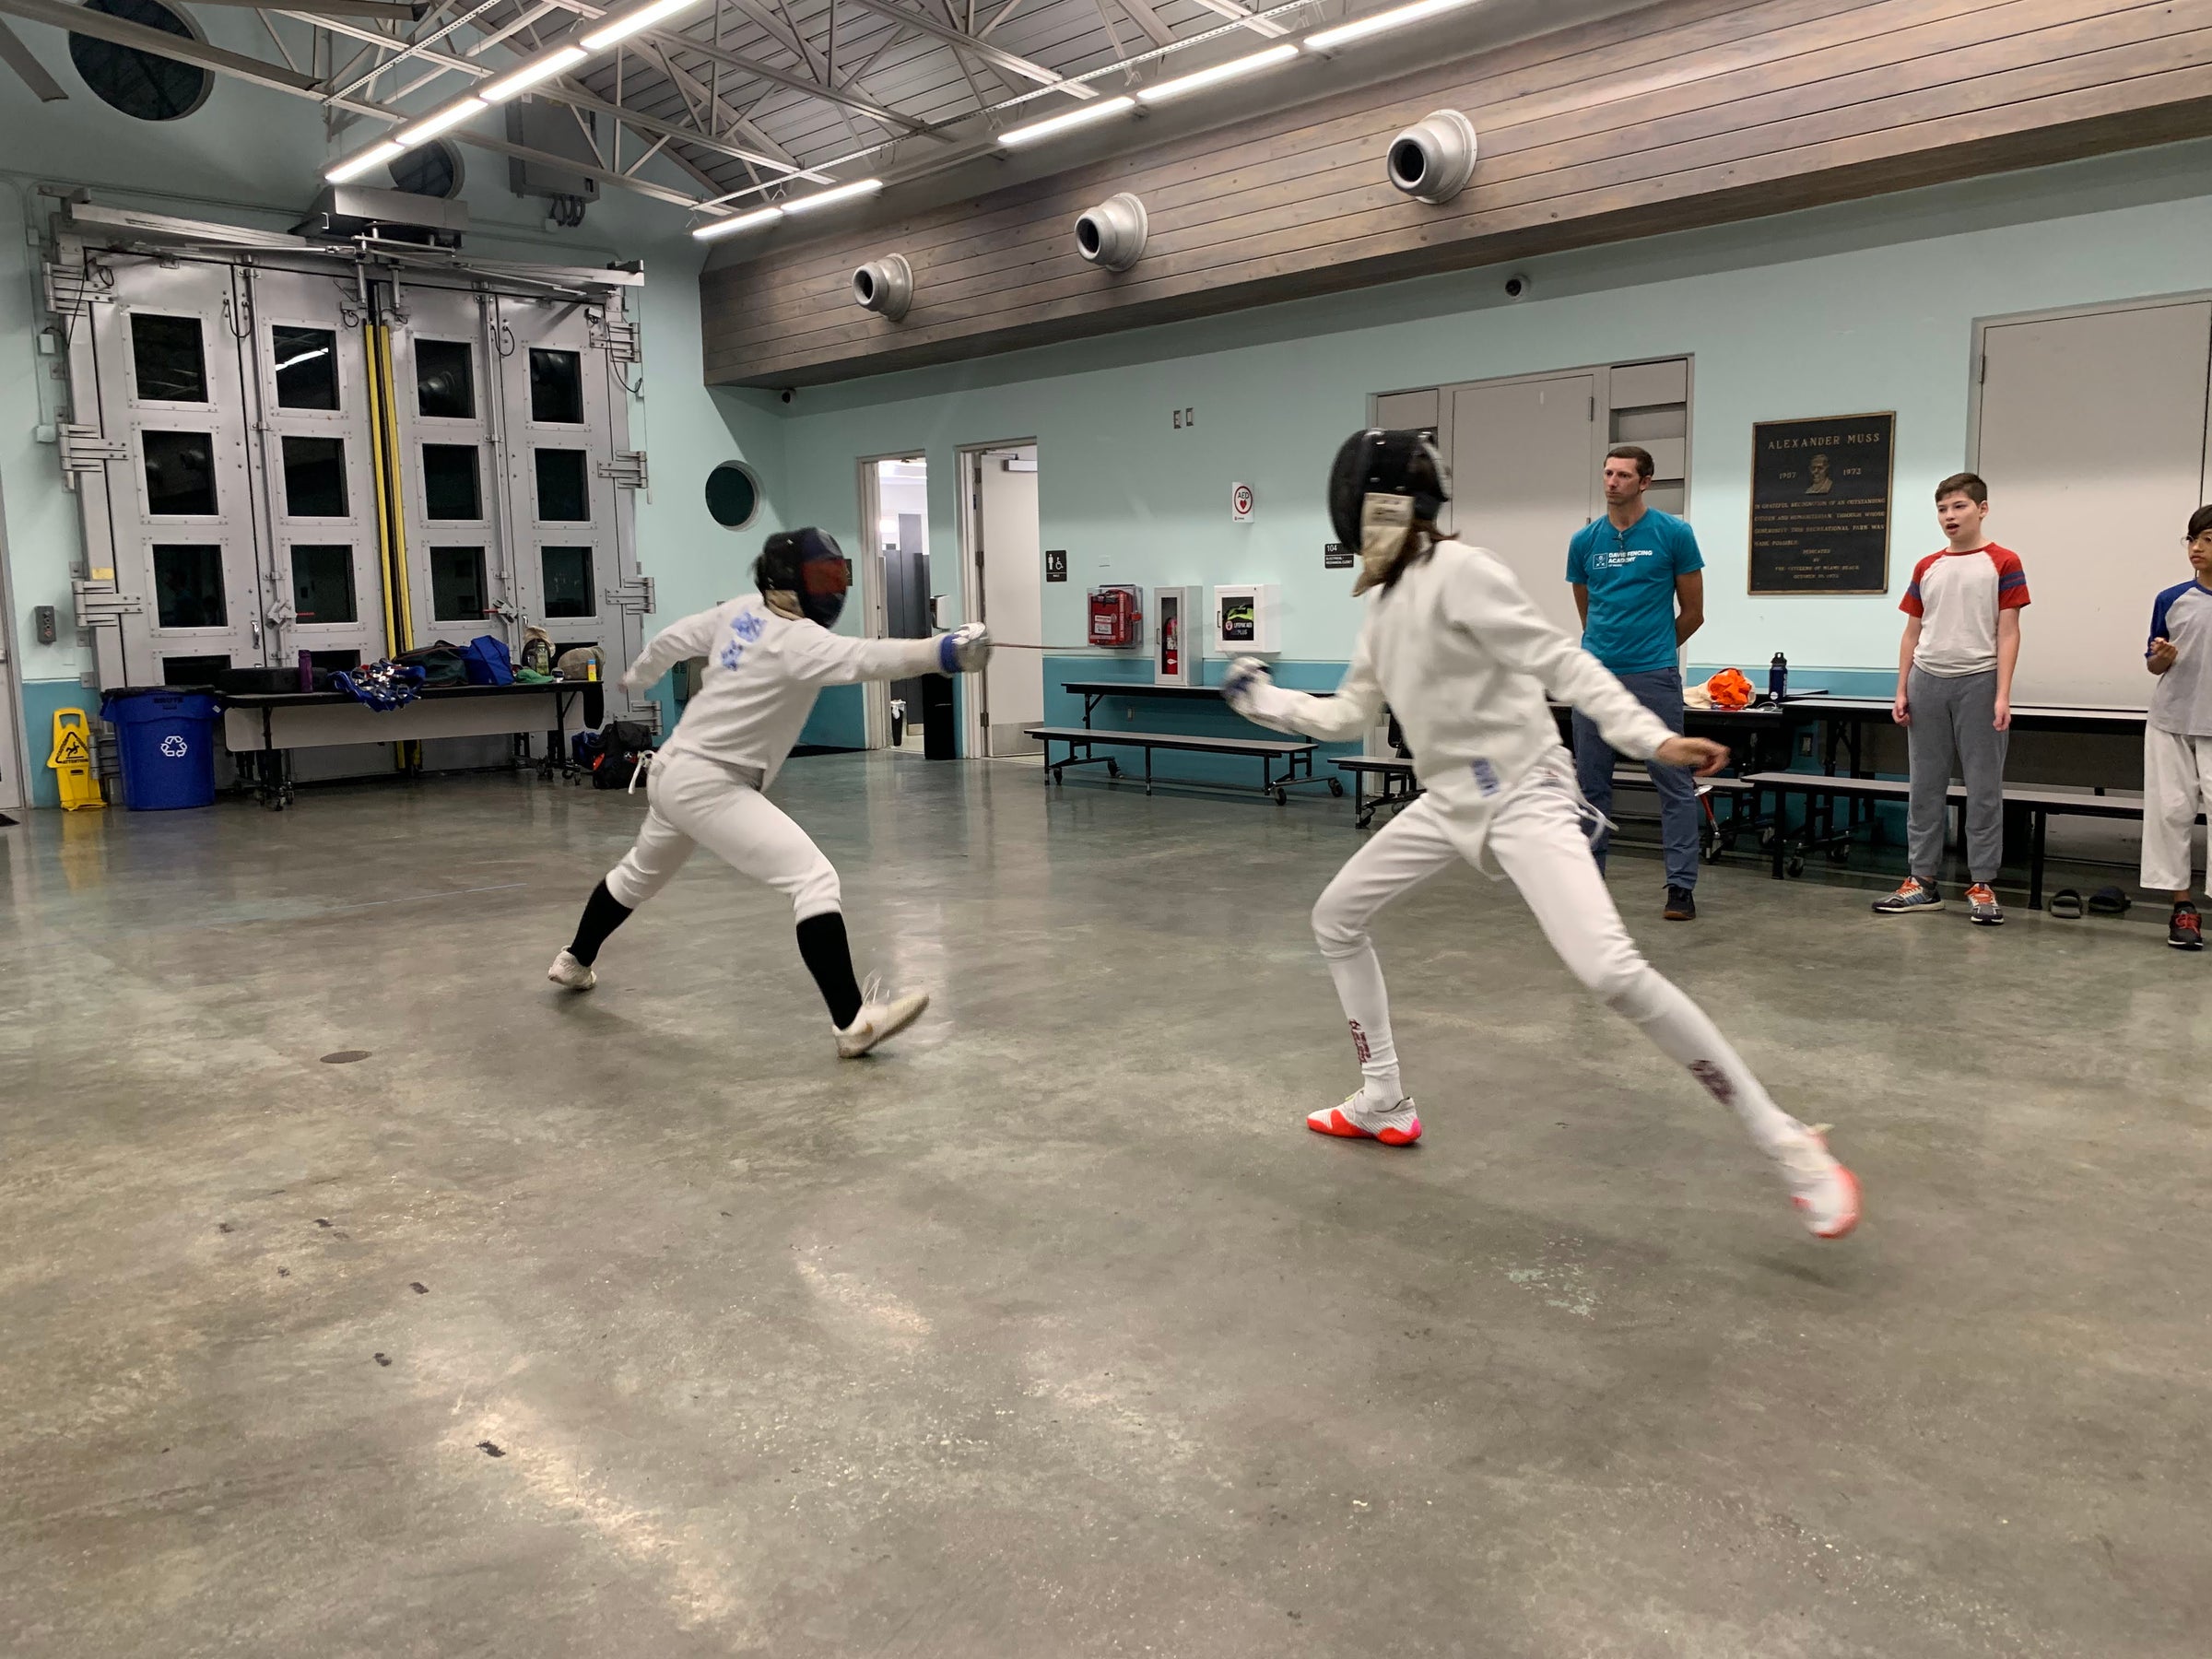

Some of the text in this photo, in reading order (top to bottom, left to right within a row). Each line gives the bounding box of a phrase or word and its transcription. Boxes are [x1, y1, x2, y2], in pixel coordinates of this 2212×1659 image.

[1768, 433, 1880, 450] ALEXANDER MUSS
[1779, 471, 1797, 479] 1907
[1237, 491, 1250, 500] AED
[1326, 544, 1338, 552] 104
